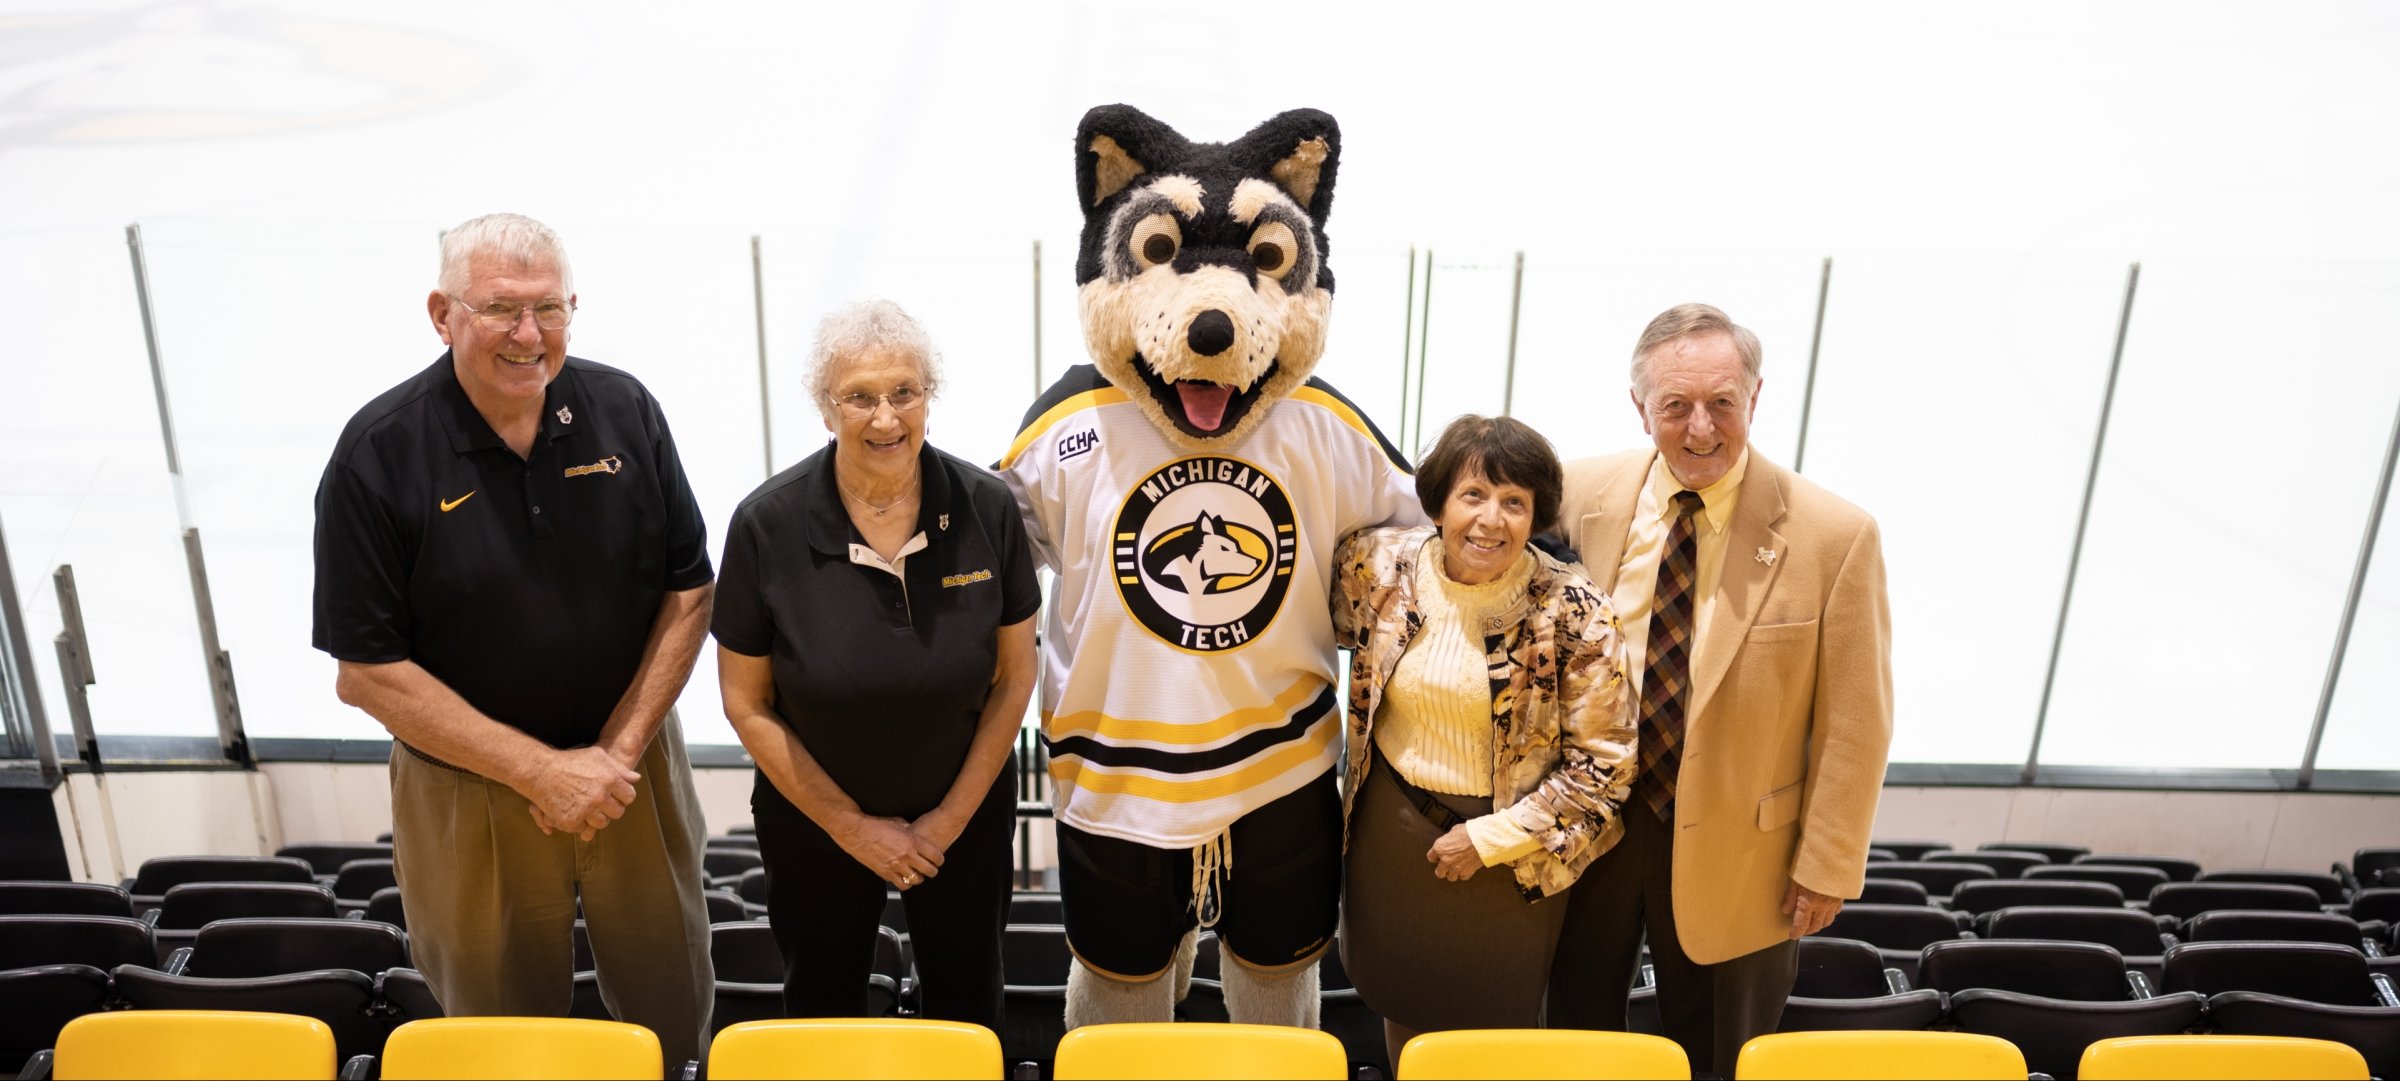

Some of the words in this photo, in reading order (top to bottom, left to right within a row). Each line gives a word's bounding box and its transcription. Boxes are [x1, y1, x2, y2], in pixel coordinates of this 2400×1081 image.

[1059, 428, 1099, 457] CCHA
[1141, 459, 1271, 503] MICHIGAN
[1181, 621, 1249, 649] TECH
